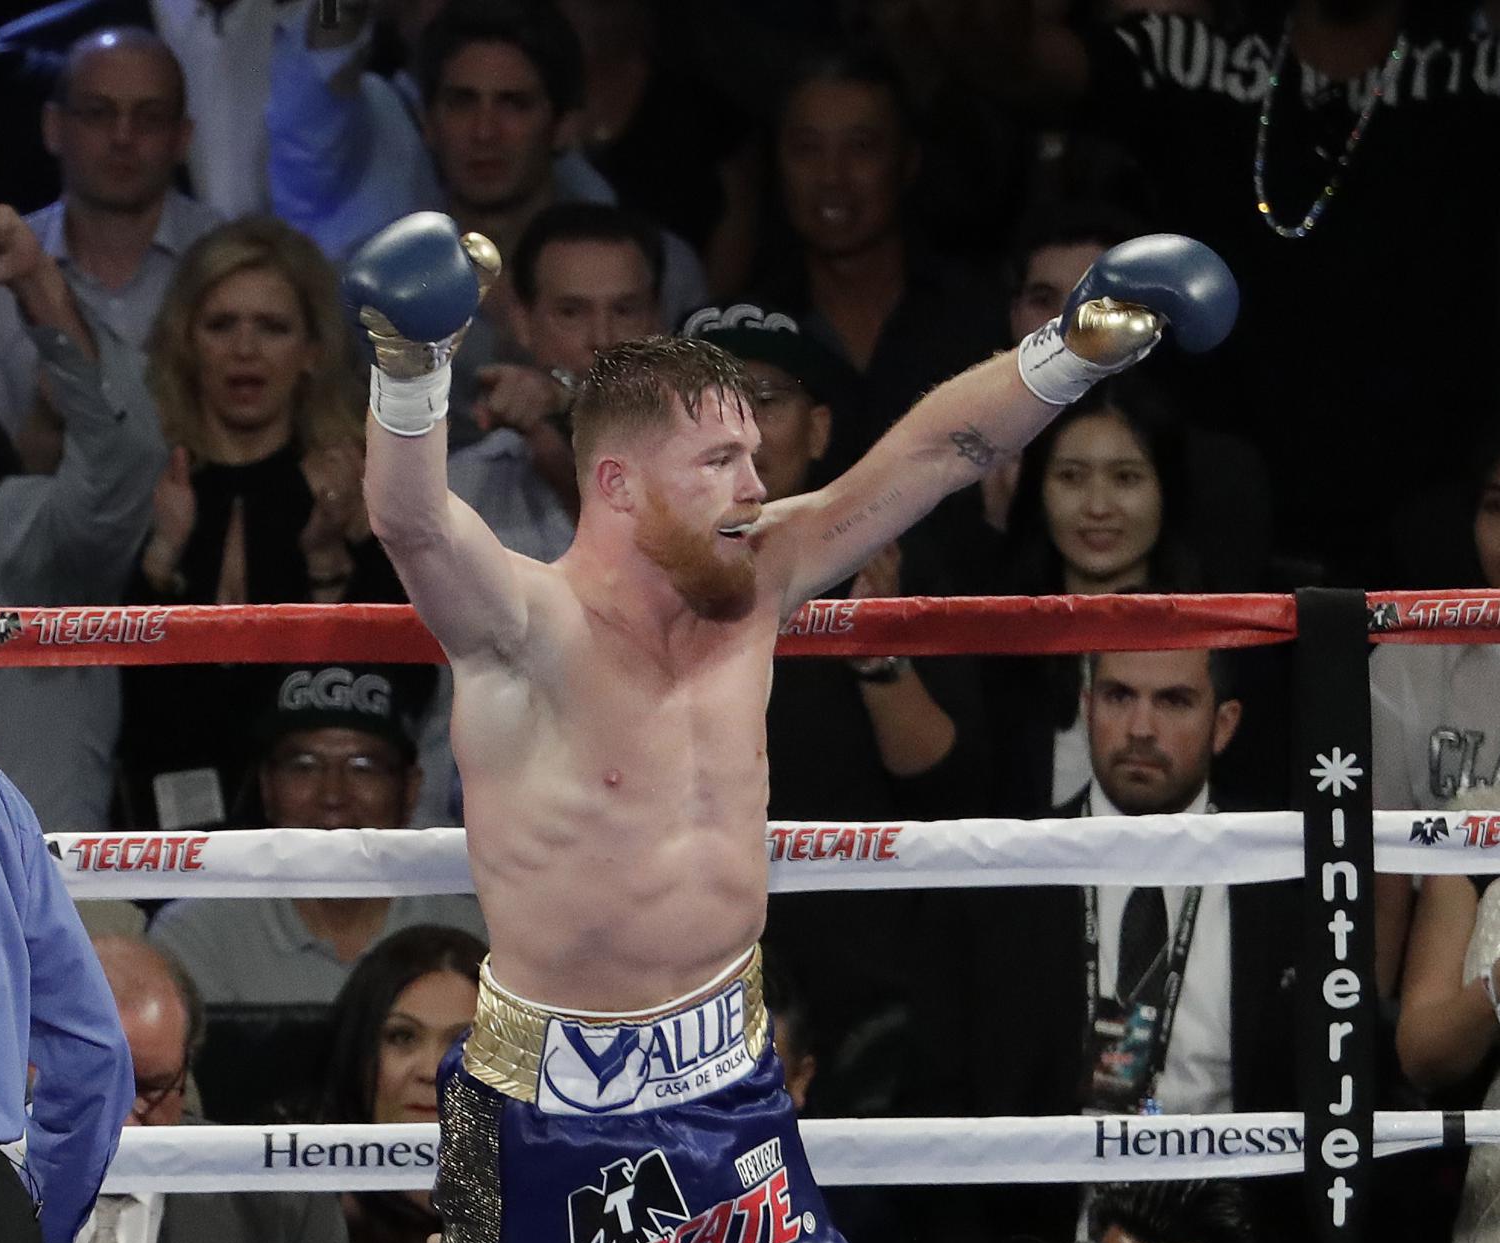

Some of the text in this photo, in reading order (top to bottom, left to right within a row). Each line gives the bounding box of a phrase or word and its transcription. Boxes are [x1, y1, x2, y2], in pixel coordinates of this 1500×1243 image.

[30, 609, 171, 645] TECATE
[779, 599, 861, 634] ATE
[278, 667, 391, 716] GGG
[69, 837, 210, 872] TECATE
[765, 827, 903, 862] TECATE
[655, 1050, 747, 1099] CASA DE BOLSA
[263, 1132, 436, 1168] Hennes
